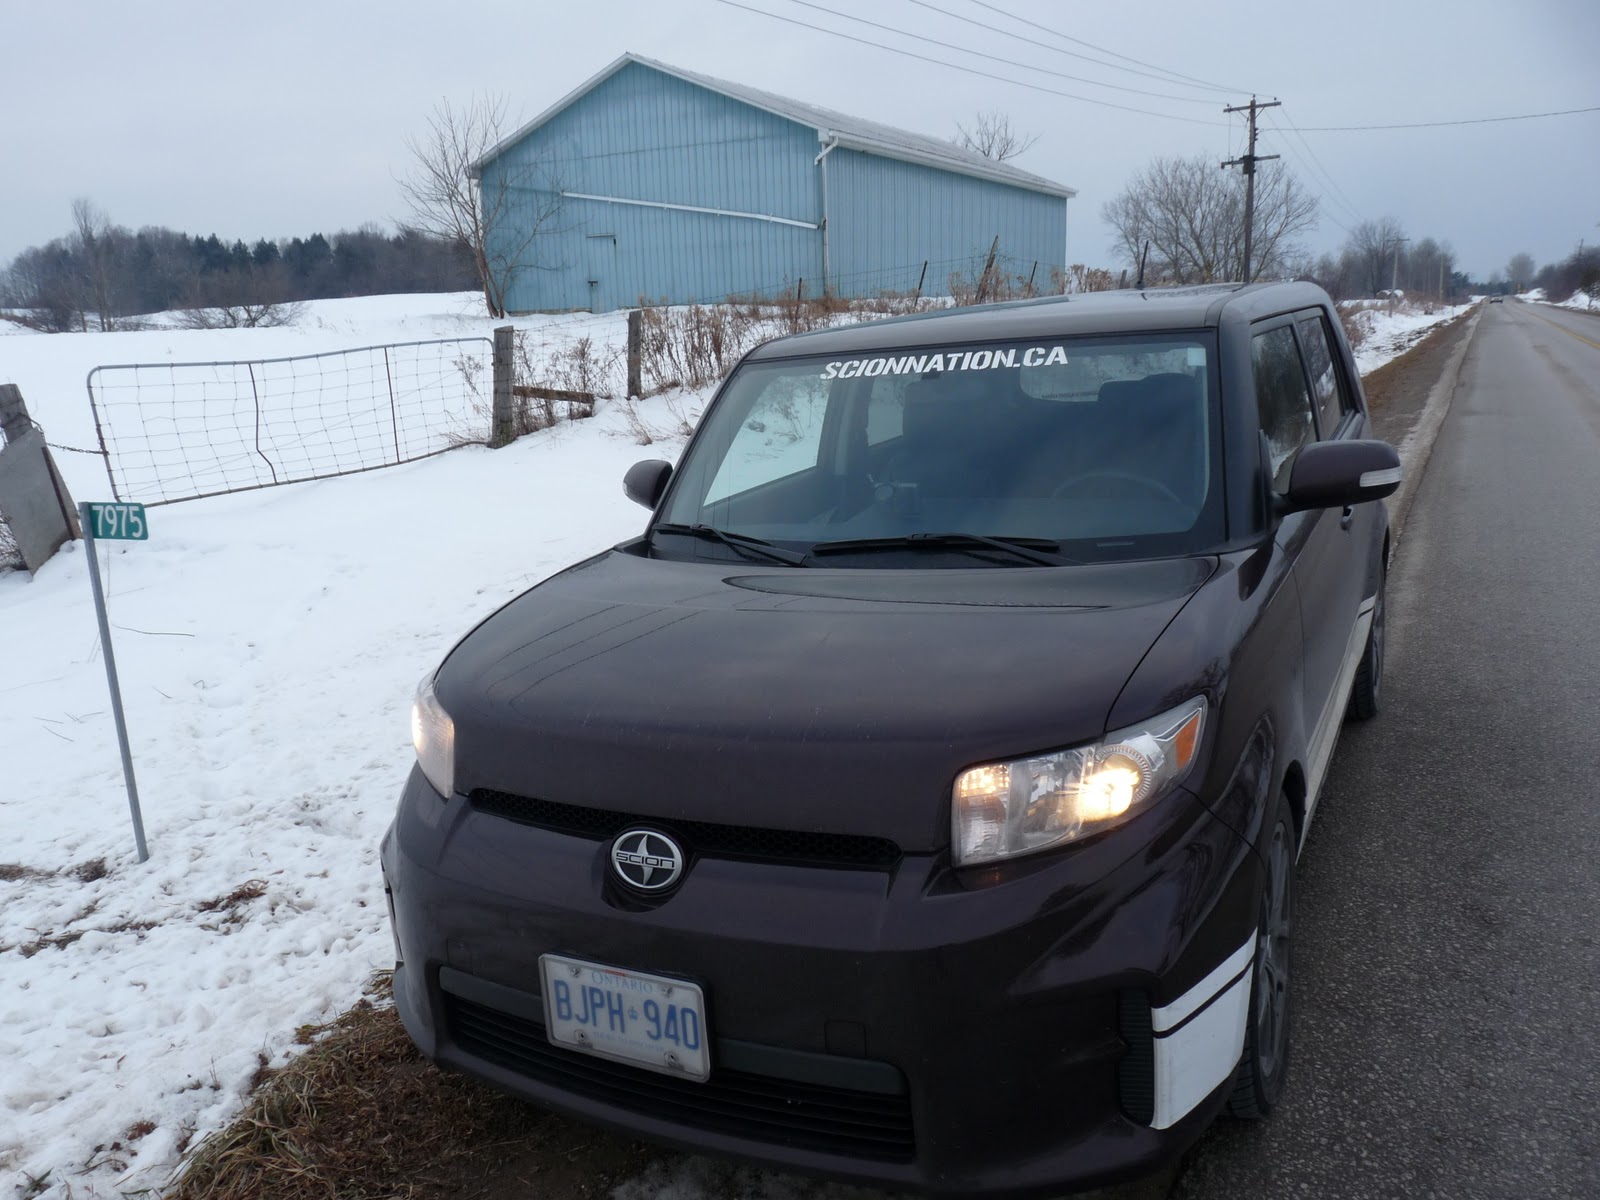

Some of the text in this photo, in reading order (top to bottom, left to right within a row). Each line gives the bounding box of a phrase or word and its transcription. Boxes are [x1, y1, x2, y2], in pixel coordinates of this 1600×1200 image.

[820, 346, 1068, 380] SCIONNATION.CA
[92, 505, 143, 537] 7975
[616, 852, 675, 868] SCION
[592, 971, 653, 994] ONTARIO
[553, 979, 700, 1050] BJPH 940
